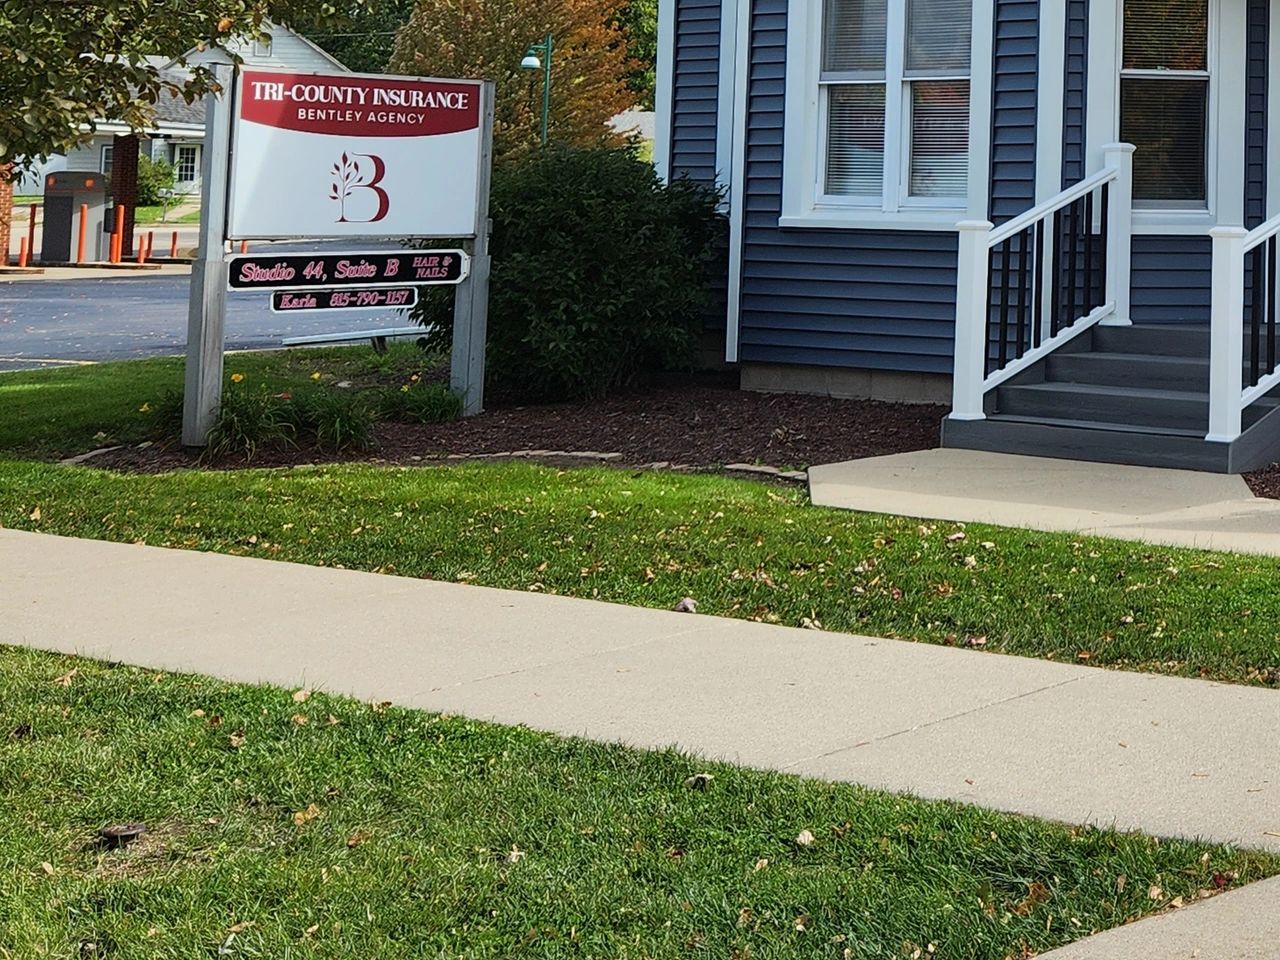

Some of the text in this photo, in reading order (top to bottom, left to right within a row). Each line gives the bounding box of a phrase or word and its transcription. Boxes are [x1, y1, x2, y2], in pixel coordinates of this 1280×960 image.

[251, 81, 469, 110] TRI-COUNTY INSURANCE
[298, 108, 425, 124] BENTLEY AGENCY
[239, 258, 400, 282] Studio 44, Suite B
[412, 256, 453, 268] HAIR &
[415, 267, 449, 279] NAILS
[329, 290, 410, 307] 815-790-1157
